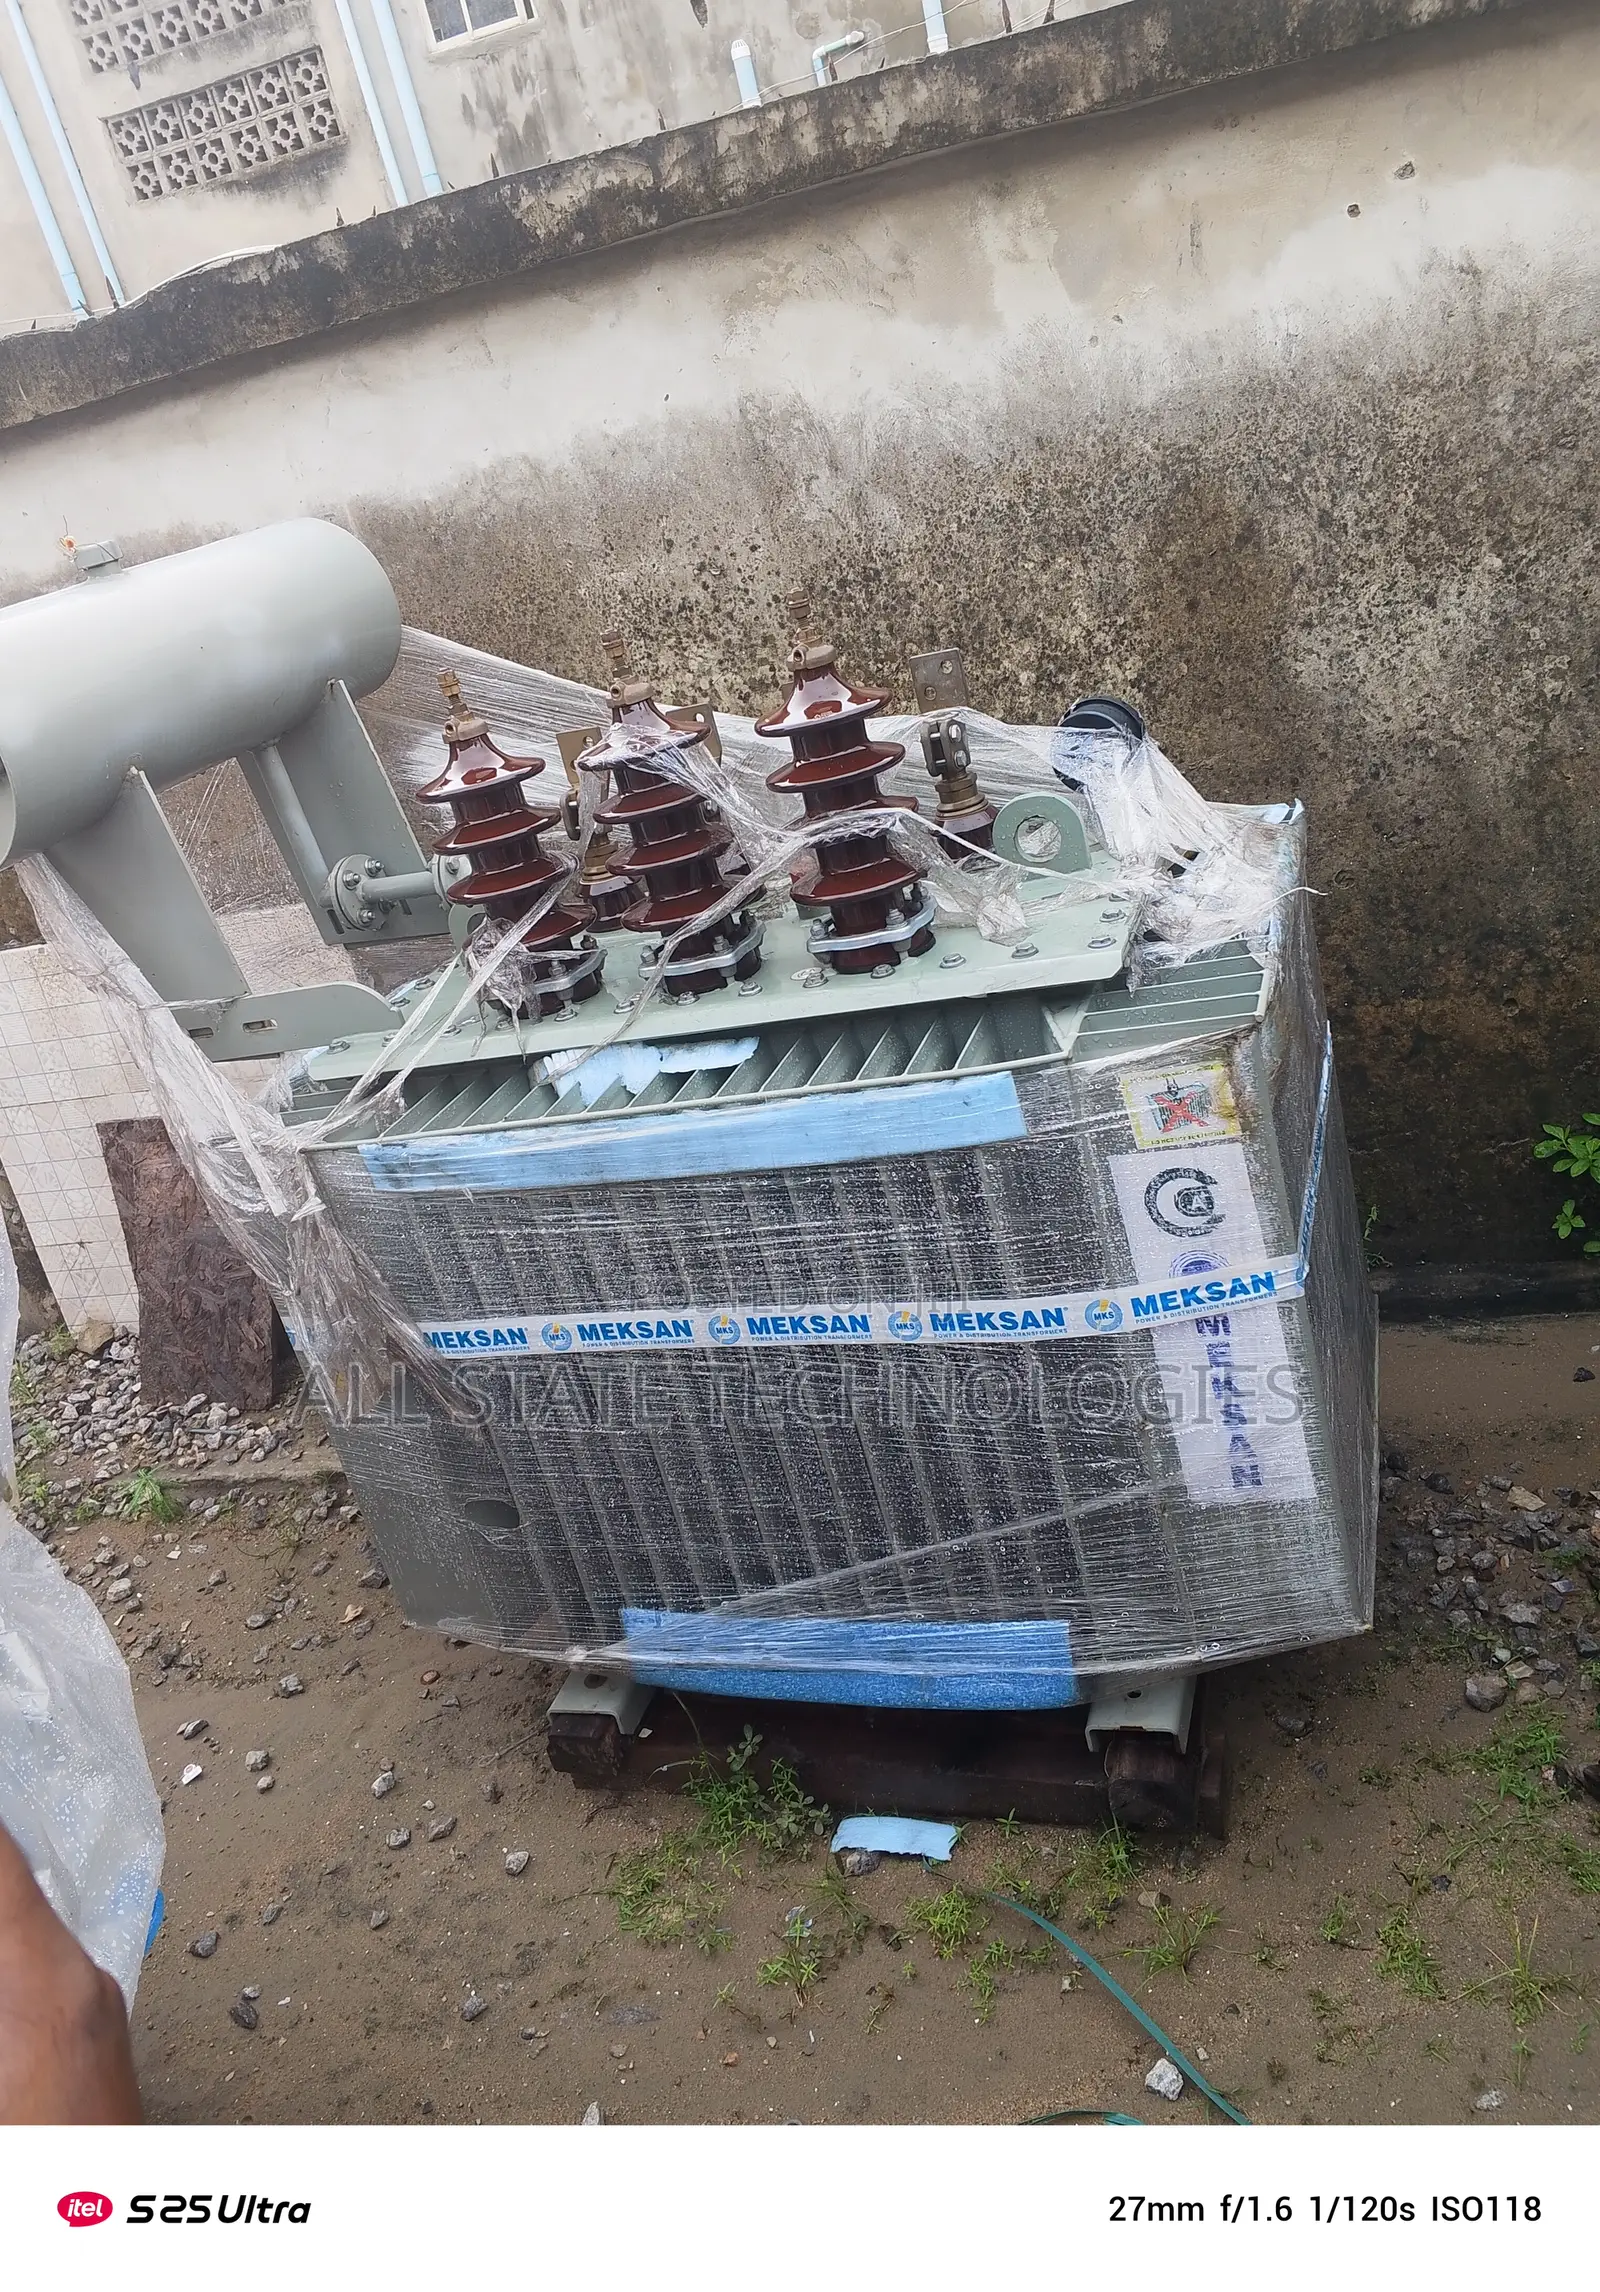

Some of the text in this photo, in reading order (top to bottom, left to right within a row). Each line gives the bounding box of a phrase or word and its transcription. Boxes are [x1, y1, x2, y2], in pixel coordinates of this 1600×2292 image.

[423, 1327, 529, 1349] MEKSAN
[576, 1319, 693, 1342] MEKSAN
[716, 1326, 734, 1335] MKS
[746, 1314, 871, 1336] MEKSAN
[896, 1322, 915, 1330] MKS
[929, 1307, 1066, 1332] MEKSAN
[1093, 1311, 1115, 1321] MKS
[1131, 1271, 1276, 1318] MEKSAN
[1135, 1315, 1161, 1325] POWER
[1169, 1303, 1220, 1319] DISTRIBUTION
[1221, 1291, 1278, 1308] TRANSFORMERS
[1014, 1328, 1068, 1337] TRANSFORMERS
[610, 1340, 649, 1348] DISTRIBUTION
